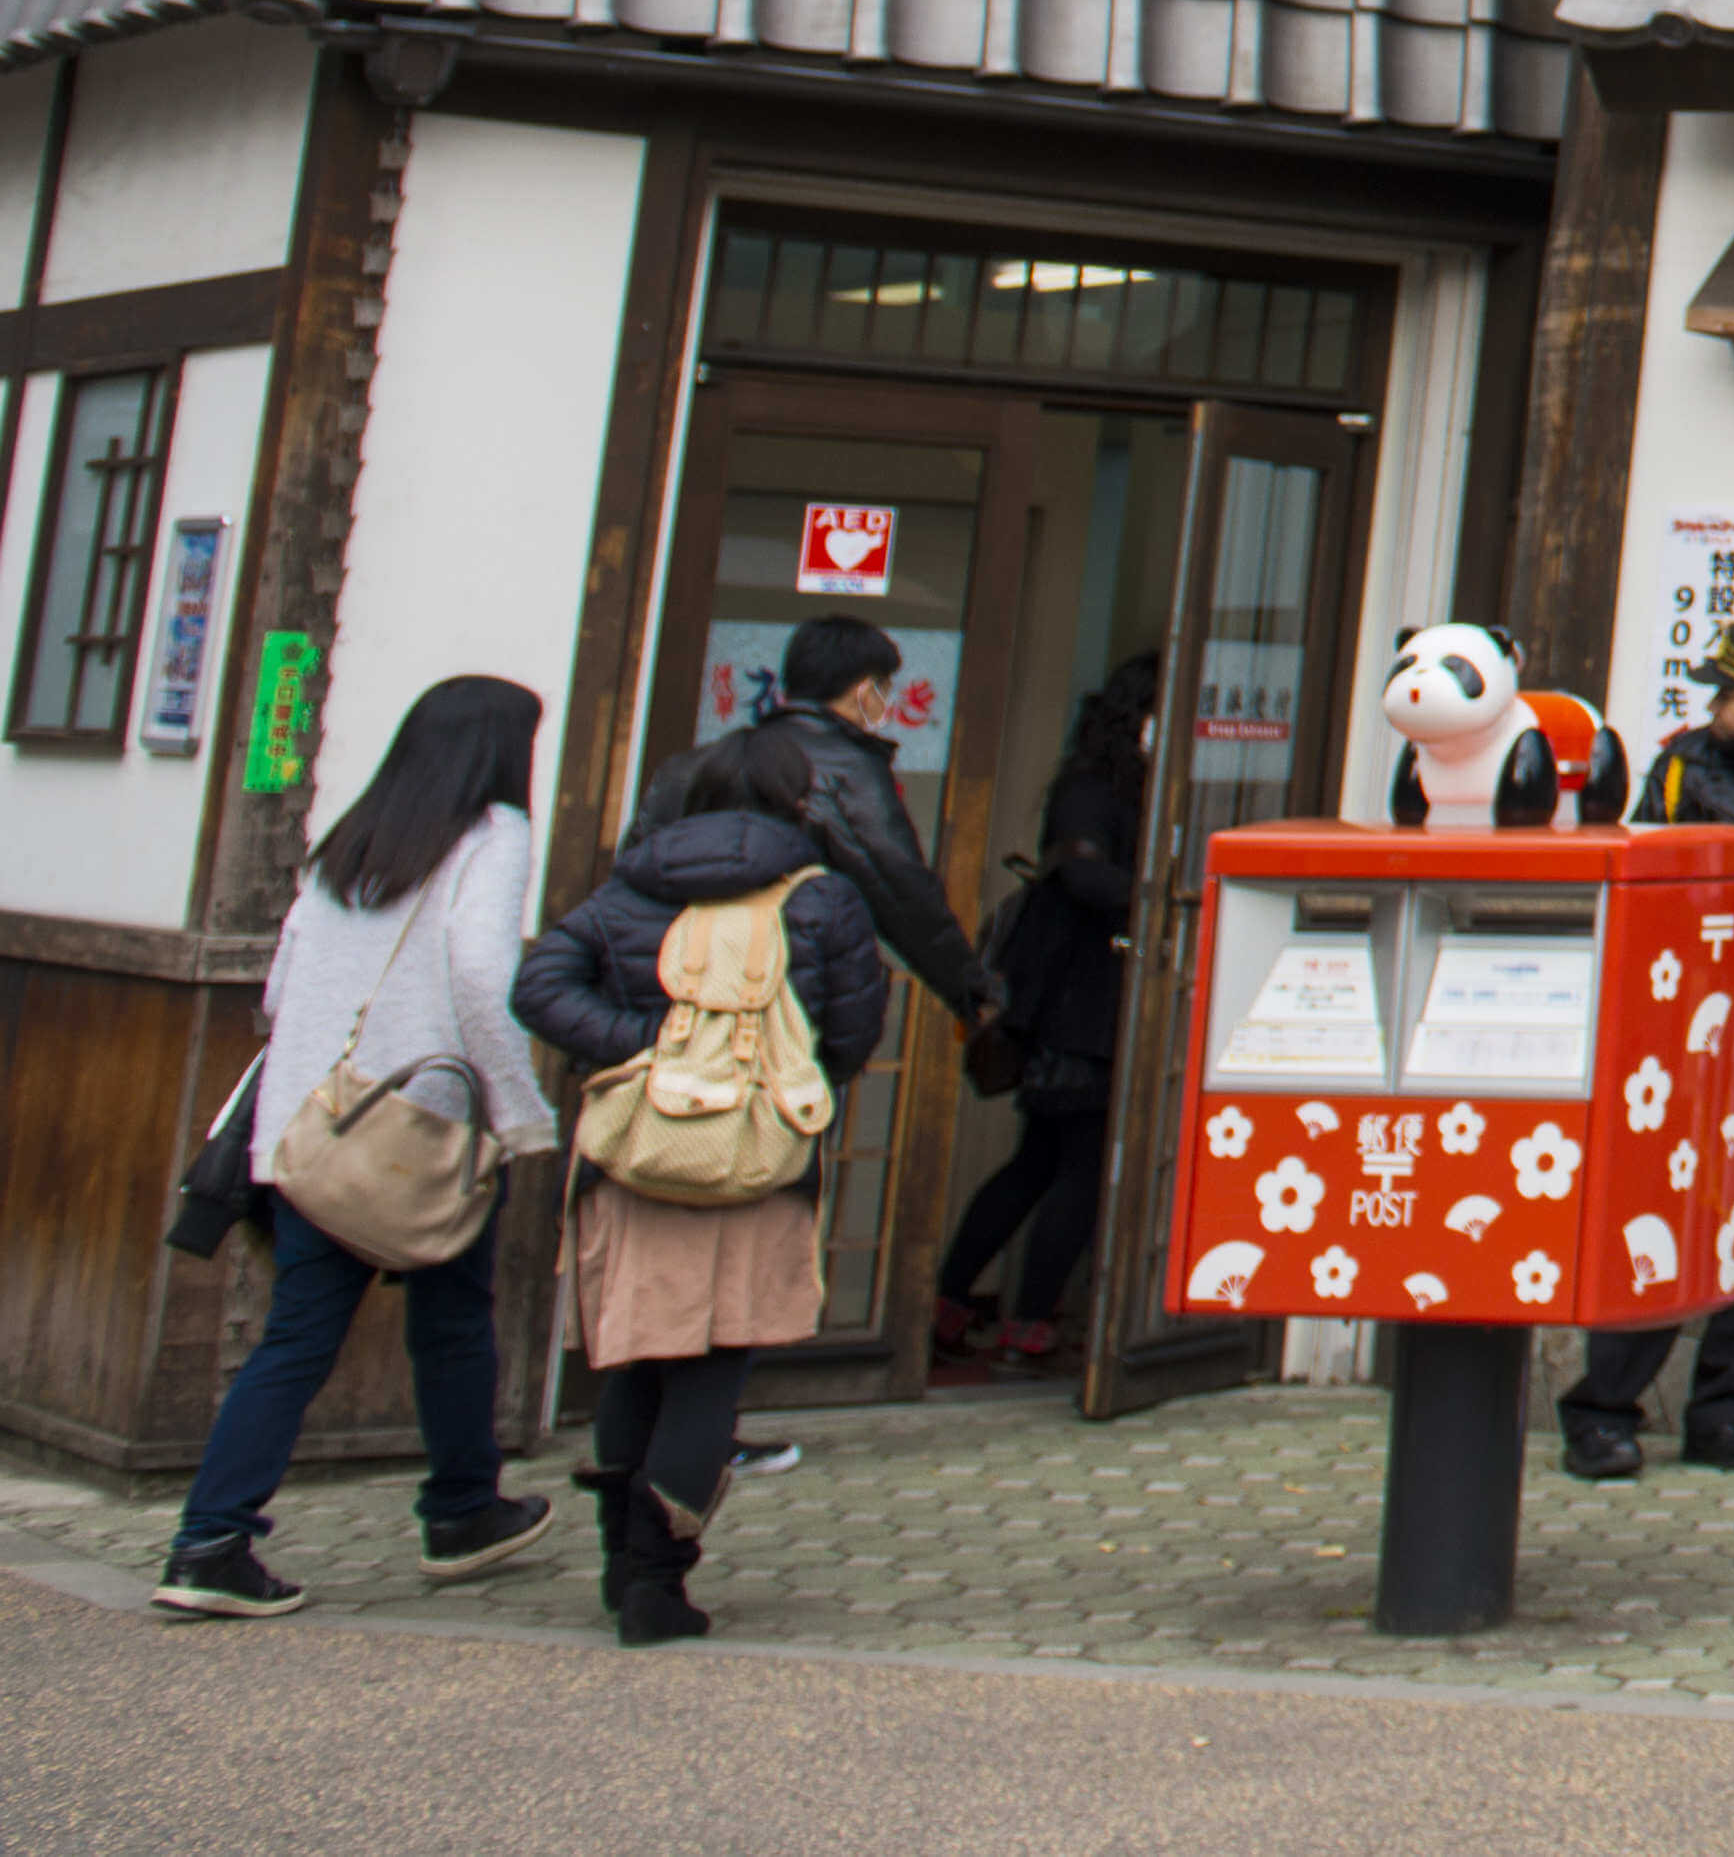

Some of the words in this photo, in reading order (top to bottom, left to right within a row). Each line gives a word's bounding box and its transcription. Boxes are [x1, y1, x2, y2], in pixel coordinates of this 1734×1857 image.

[815, 508, 888, 531] AED
[1355, 1113, 1426, 1158] 郵便
[1348, 1189, 1419, 1229] POST
